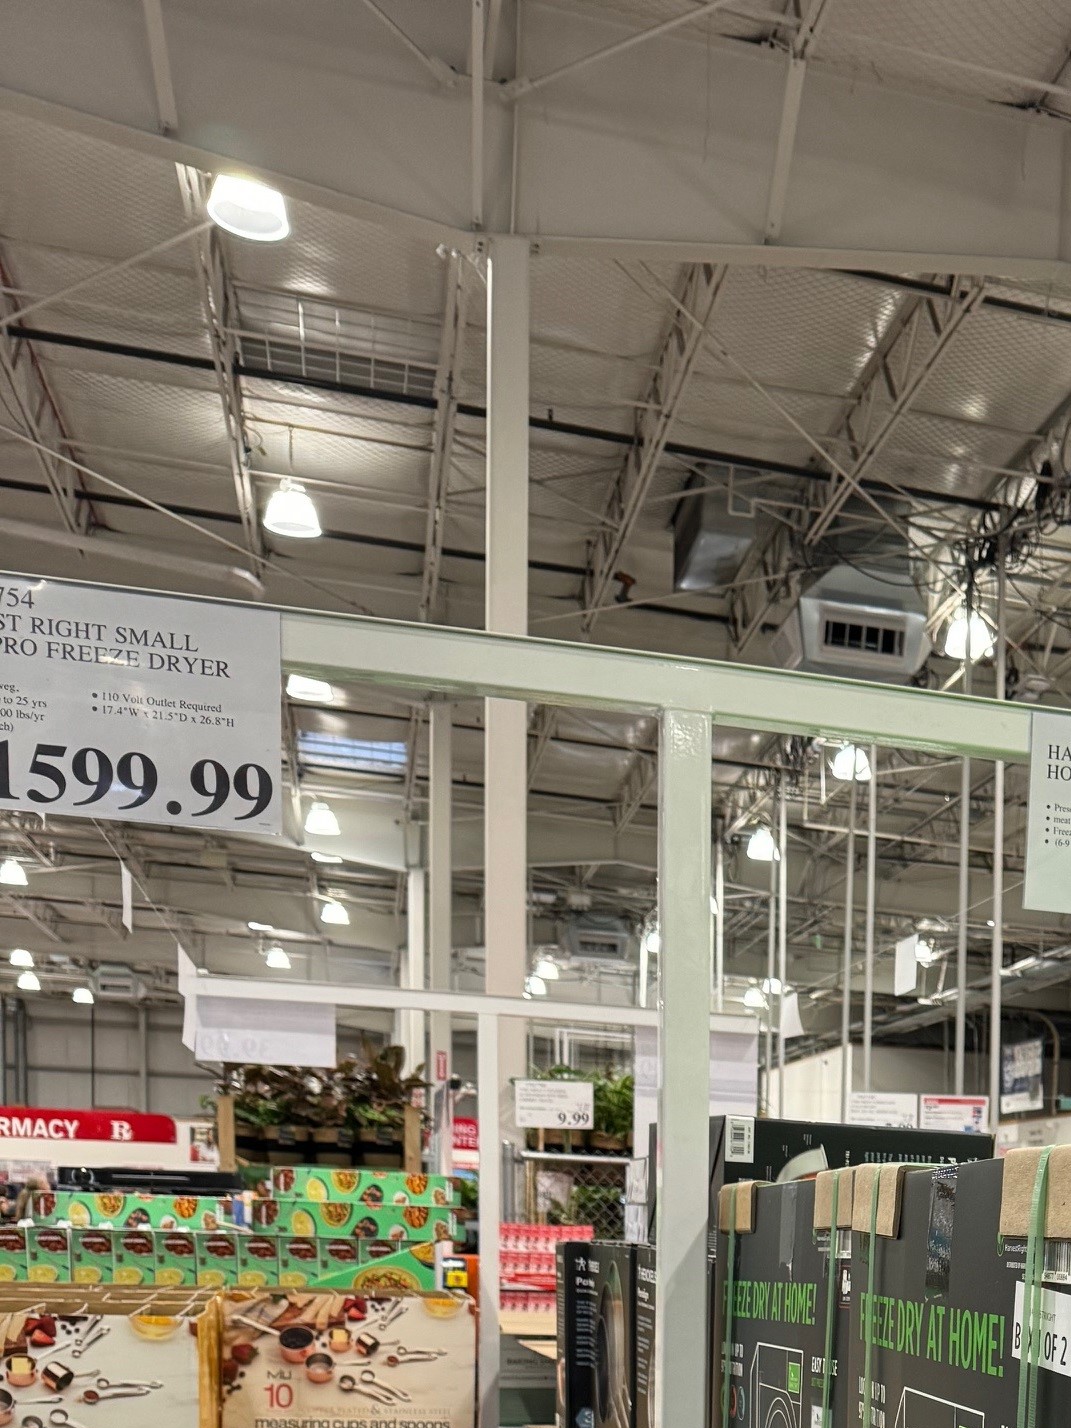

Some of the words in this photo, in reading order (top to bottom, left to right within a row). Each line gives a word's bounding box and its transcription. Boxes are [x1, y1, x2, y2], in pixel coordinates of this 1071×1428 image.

[31, 617, 107, 642] RIGHT
[115, 627, 199, 652] SMALL
[46, 641, 140, 667] FREEZE
[148, 652, 230, 678] DRYER
[16, 696, 28, 706] 25
[31, 700, 47, 709] yrs
[16, 709, 45, 722] lbs/yr
[102, 692, 120, 701] 110
[122, 693, 143, 705] Volt
[146, 697, 177, 709] Outlet
[179, 699, 222, 713] Required
[0, 739, 273, 820] 1599.99
[1053, 816, 1071, 825] meat
[1055, 838, 1070, 848] (6-9
[557, 1112, 590, 1126] 9.99
[753, 1281, 770, 1320] DRY
[771, 1282, 783, 1322] AT
[784, 1282, 817, 1325] HOME!
[897, 1299, 923, 1361] DRY
[927, 1304, 946, 1364] AT
[948, 1307, 1006, 1378] HOME!
[1045, 1331, 1057, 1362] OF
[1060, 1336, 1067, 1366] 2
[264, 1383, 294, 1409] 10
